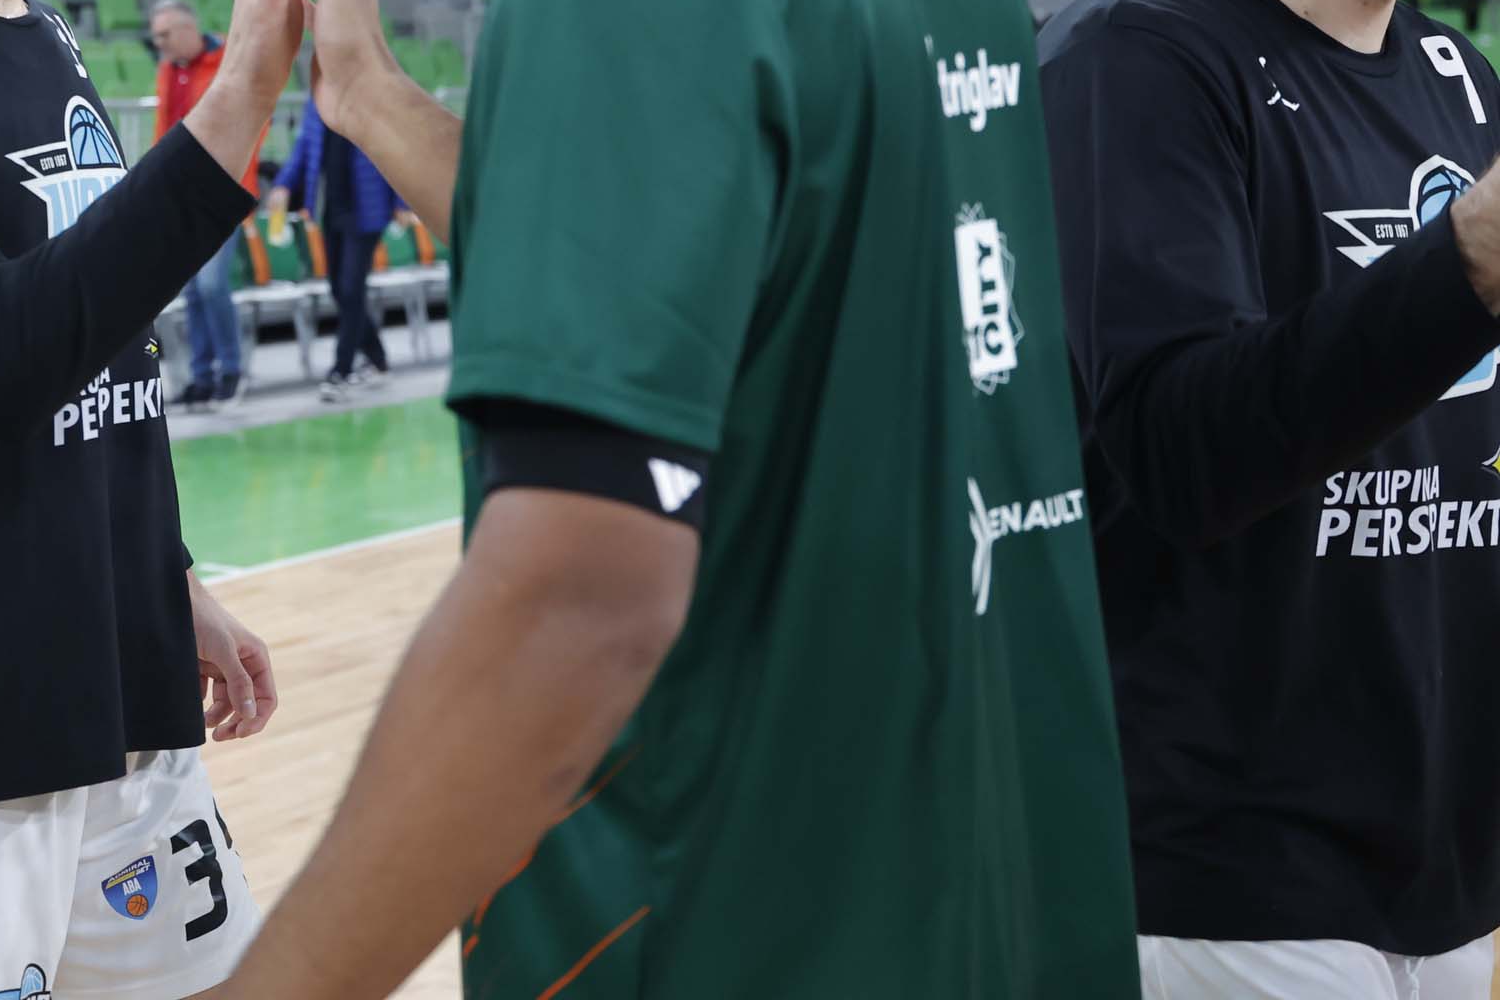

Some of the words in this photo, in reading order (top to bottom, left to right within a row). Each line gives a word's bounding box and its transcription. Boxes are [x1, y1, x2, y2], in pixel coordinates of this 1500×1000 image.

[1420, 35, 1487, 124] 9
[1323, 465, 1440, 505] SKUPINA
[986, 488, 1084, 541] ENAULT
[122, 877, 142, 896] ABA
